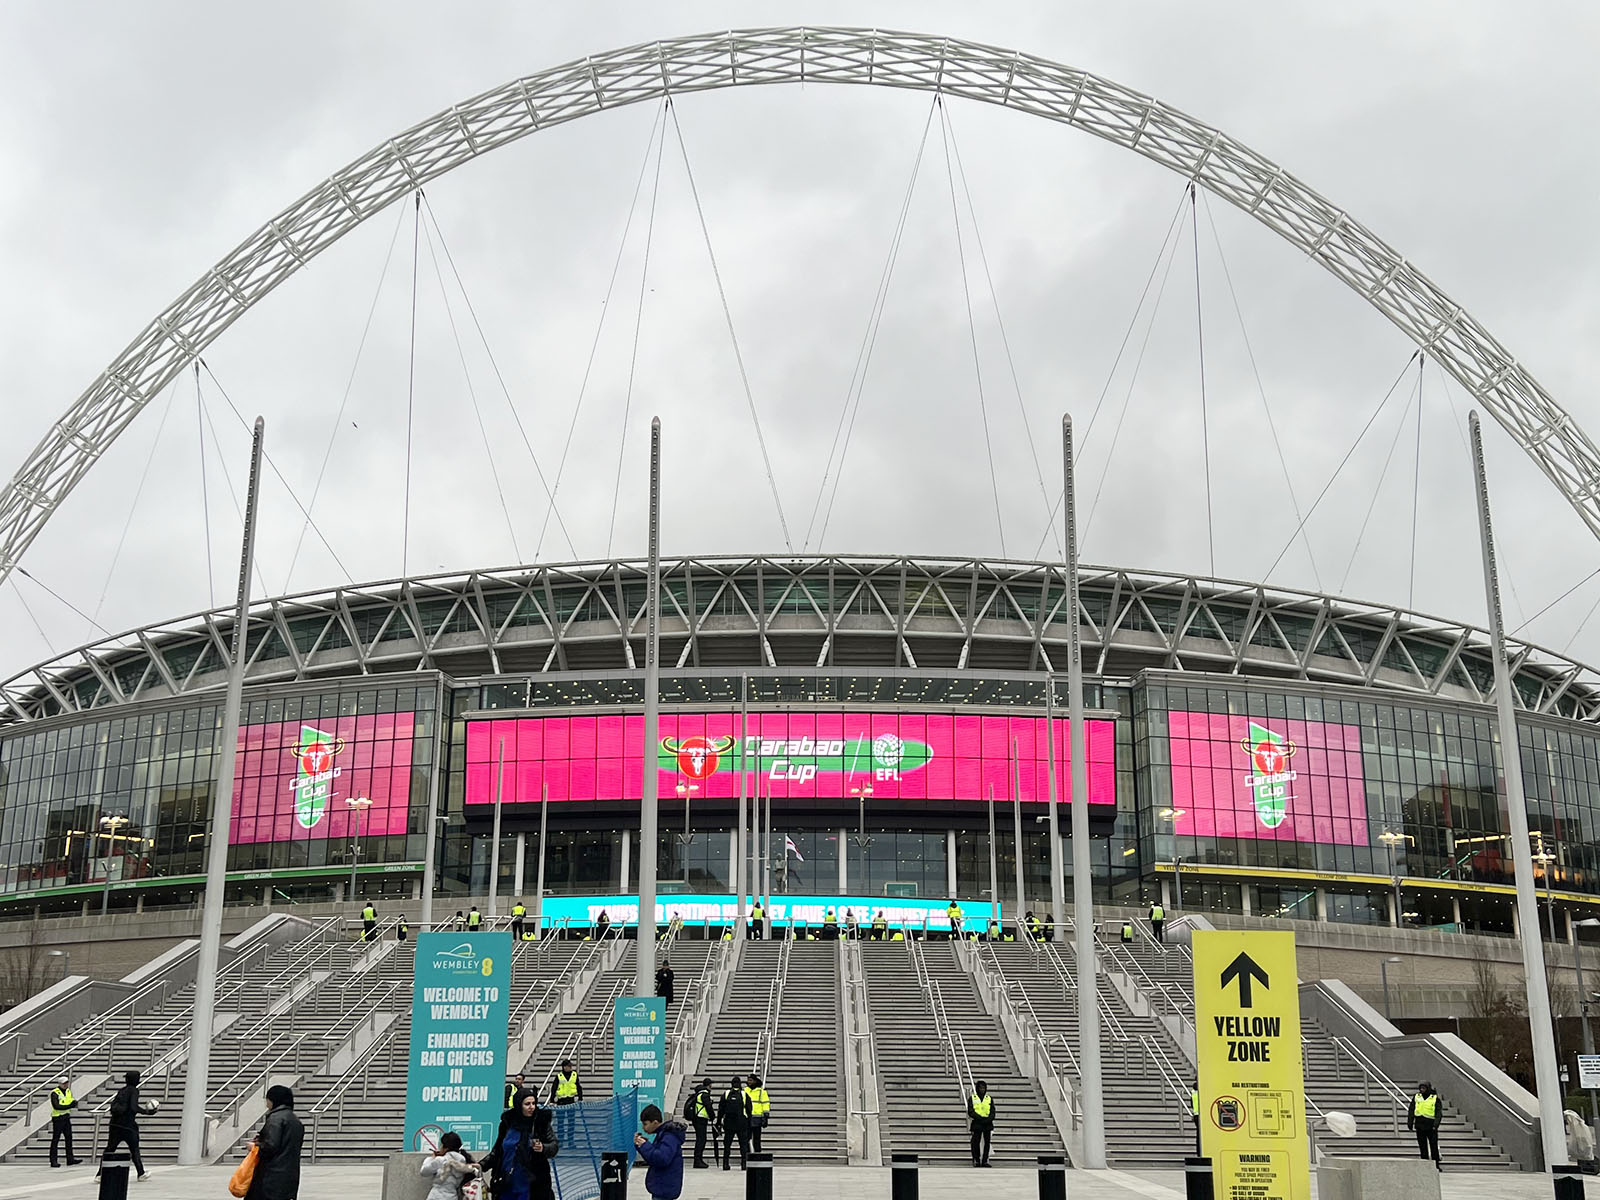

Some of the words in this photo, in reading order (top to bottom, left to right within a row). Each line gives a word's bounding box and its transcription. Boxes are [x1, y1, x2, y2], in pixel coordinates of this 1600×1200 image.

[745, 735, 846, 756] Carabao
[289, 766, 341, 791] Carabao
[768, 759, 818, 784] Cup
[876, 768, 903, 781] EFL
[1244, 770, 1297, 787] Carabao
[302, 784, 326, 798] Cup
[1260, 785, 1284, 798] Cup
[665, 903, 720, 921] VISITING
[792, 905, 826, 922] HAVE
[432, 961, 480, 969] WEMBLEY
[423, 987, 481, 1003] WELCOME
[483, 987, 499, 1002] TO
[430, 1004, 489, 1020] WEMBLEY
[620, 1026, 651, 1035] WELCOME
[651, 1026, 660, 1035] TO
[1214, 1016, 1280, 1037] YELLOW
[427, 1033, 489, 1049] ENHANCED
[624, 1036, 655, 1044] WEMBLEY
[420, 1051, 445, 1066] BAG
[447, 1050, 494, 1066] CHECKS
[1227, 1041, 1270, 1062] ZONE
[449, 1068, 463, 1084] IN
[422, 1086, 489, 1102] OPERATION
[1239, 1154, 1271, 1162] WARNING
